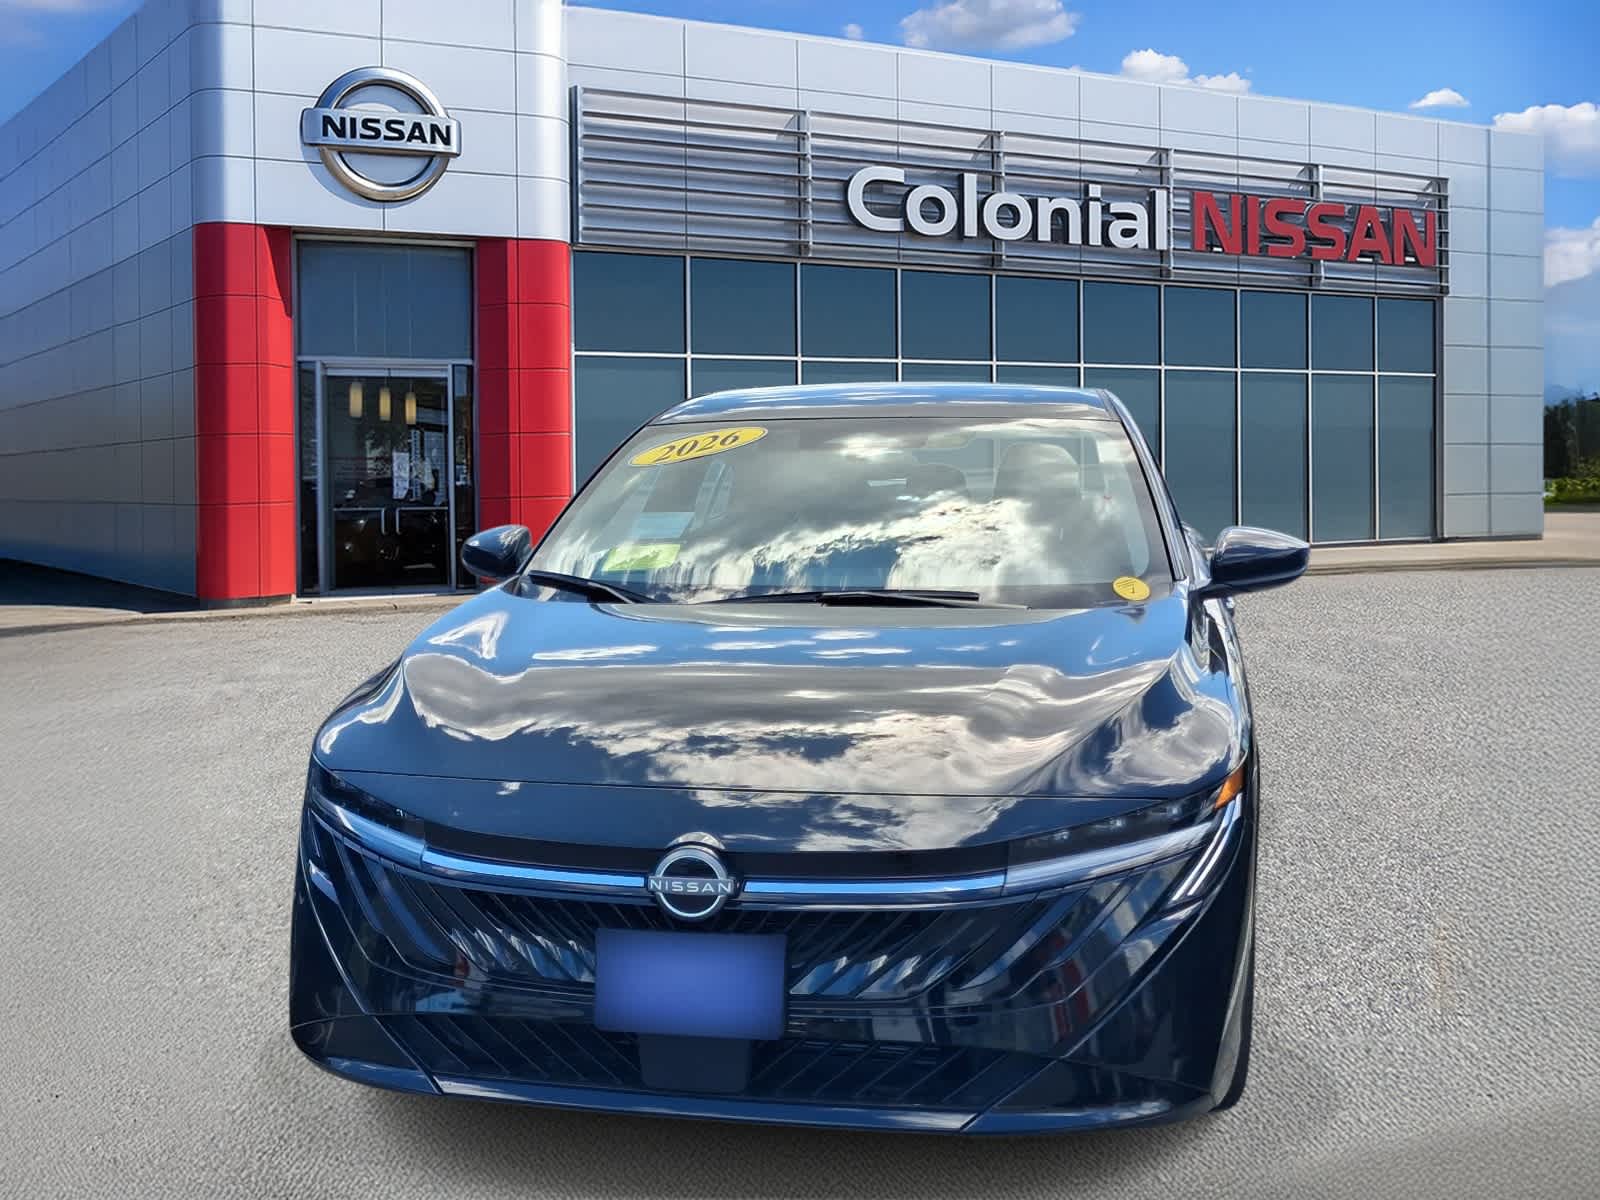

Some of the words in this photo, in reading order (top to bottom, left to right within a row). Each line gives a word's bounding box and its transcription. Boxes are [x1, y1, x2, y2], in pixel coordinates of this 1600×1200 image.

[321, 115, 451, 146] NISSAN
[847, 166, 1168, 250] Colonial
[1191, 190, 1436, 267] NISSAN
[651, 430, 743, 462] 2026
[650, 879, 732, 893] NISSAN
